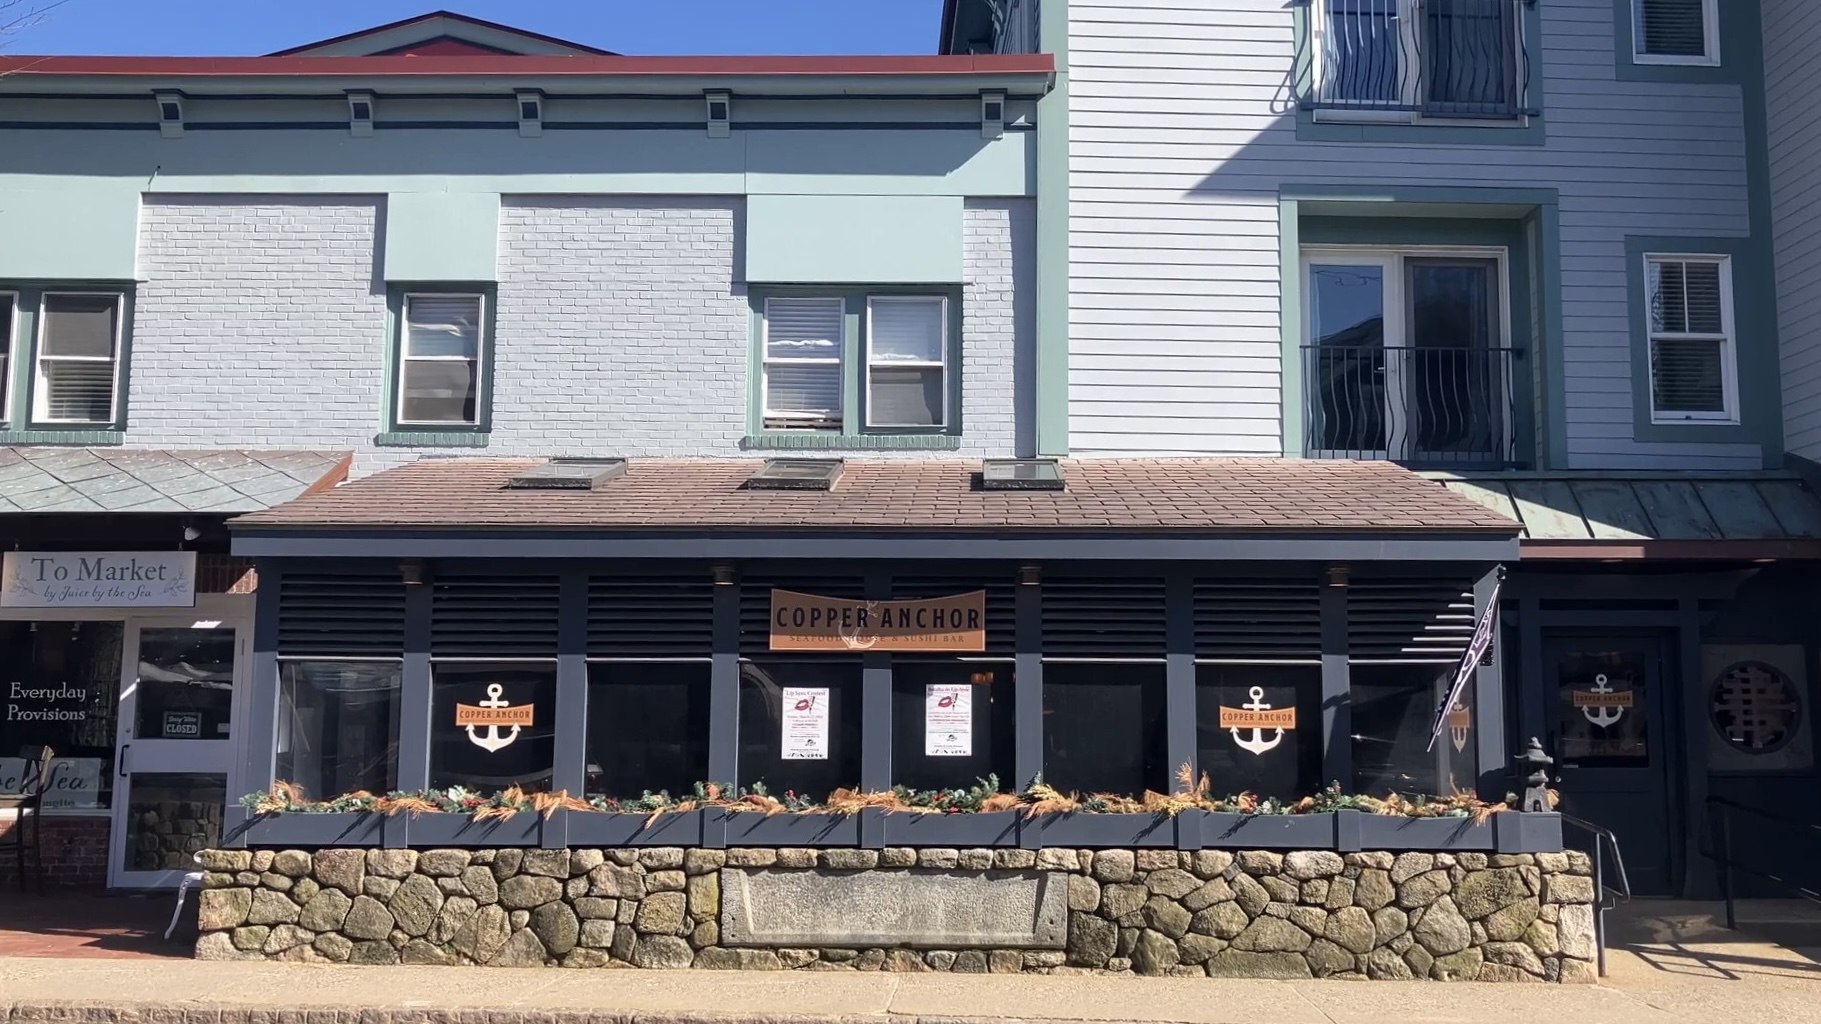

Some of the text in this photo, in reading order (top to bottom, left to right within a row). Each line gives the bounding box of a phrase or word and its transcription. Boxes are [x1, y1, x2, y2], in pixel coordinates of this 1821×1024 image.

[31, 557, 167, 581] To Market
[44, 585, 152, 601] by Juice by the Sea
[776, 607, 979, 629] COPPER ANCHOR
[789, 634, 843, 642] SEAFOOD
[903, 635, 938, 643] SUSHI
[943, 635, 965, 643] BAR
[9, 681, 87, 702] Everyday
[7, 703, 86, 721] Provisions
[459, 710, 531, 719] COPPER ANCHOR
[1222, 712, 1293, 722] COPPER ANCHOR
[166, 723, 198, 734] CLOSED
[40, 761, 88, 793] Sea
